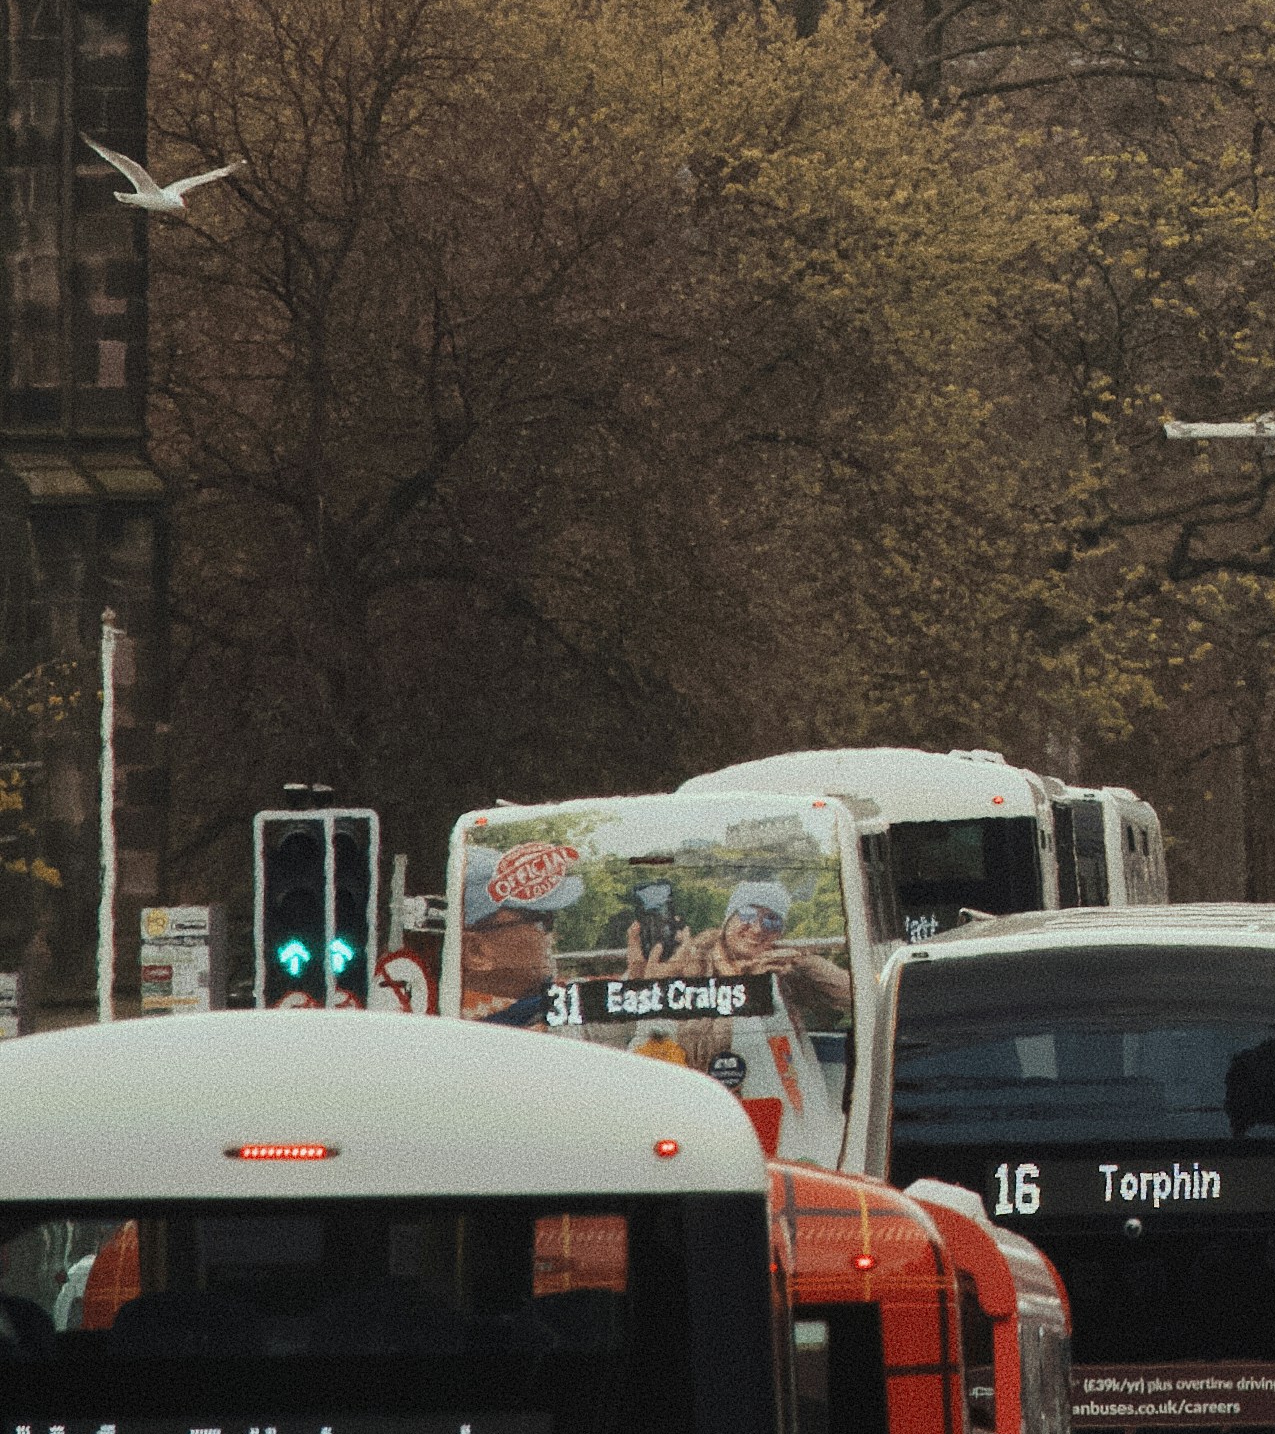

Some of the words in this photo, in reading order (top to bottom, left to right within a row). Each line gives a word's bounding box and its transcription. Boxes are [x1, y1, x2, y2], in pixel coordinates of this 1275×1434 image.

[493, 847, 569, 897] OFFICIAL
[546, 983, 582, 1026] 31
[606, 982, 663, 1014] East
[667, 979, 747, 1015] Craigs
[993, 1161, 1042, 1217] 16
[1097, 1160, 1223, 1210] Torphin
[1072, 1399, 1242, 1417] anbuses.co.uk/careers
[1147, 1377, 1174, 1395] plus
[1175, 1376, 1234, 1392] overtime
